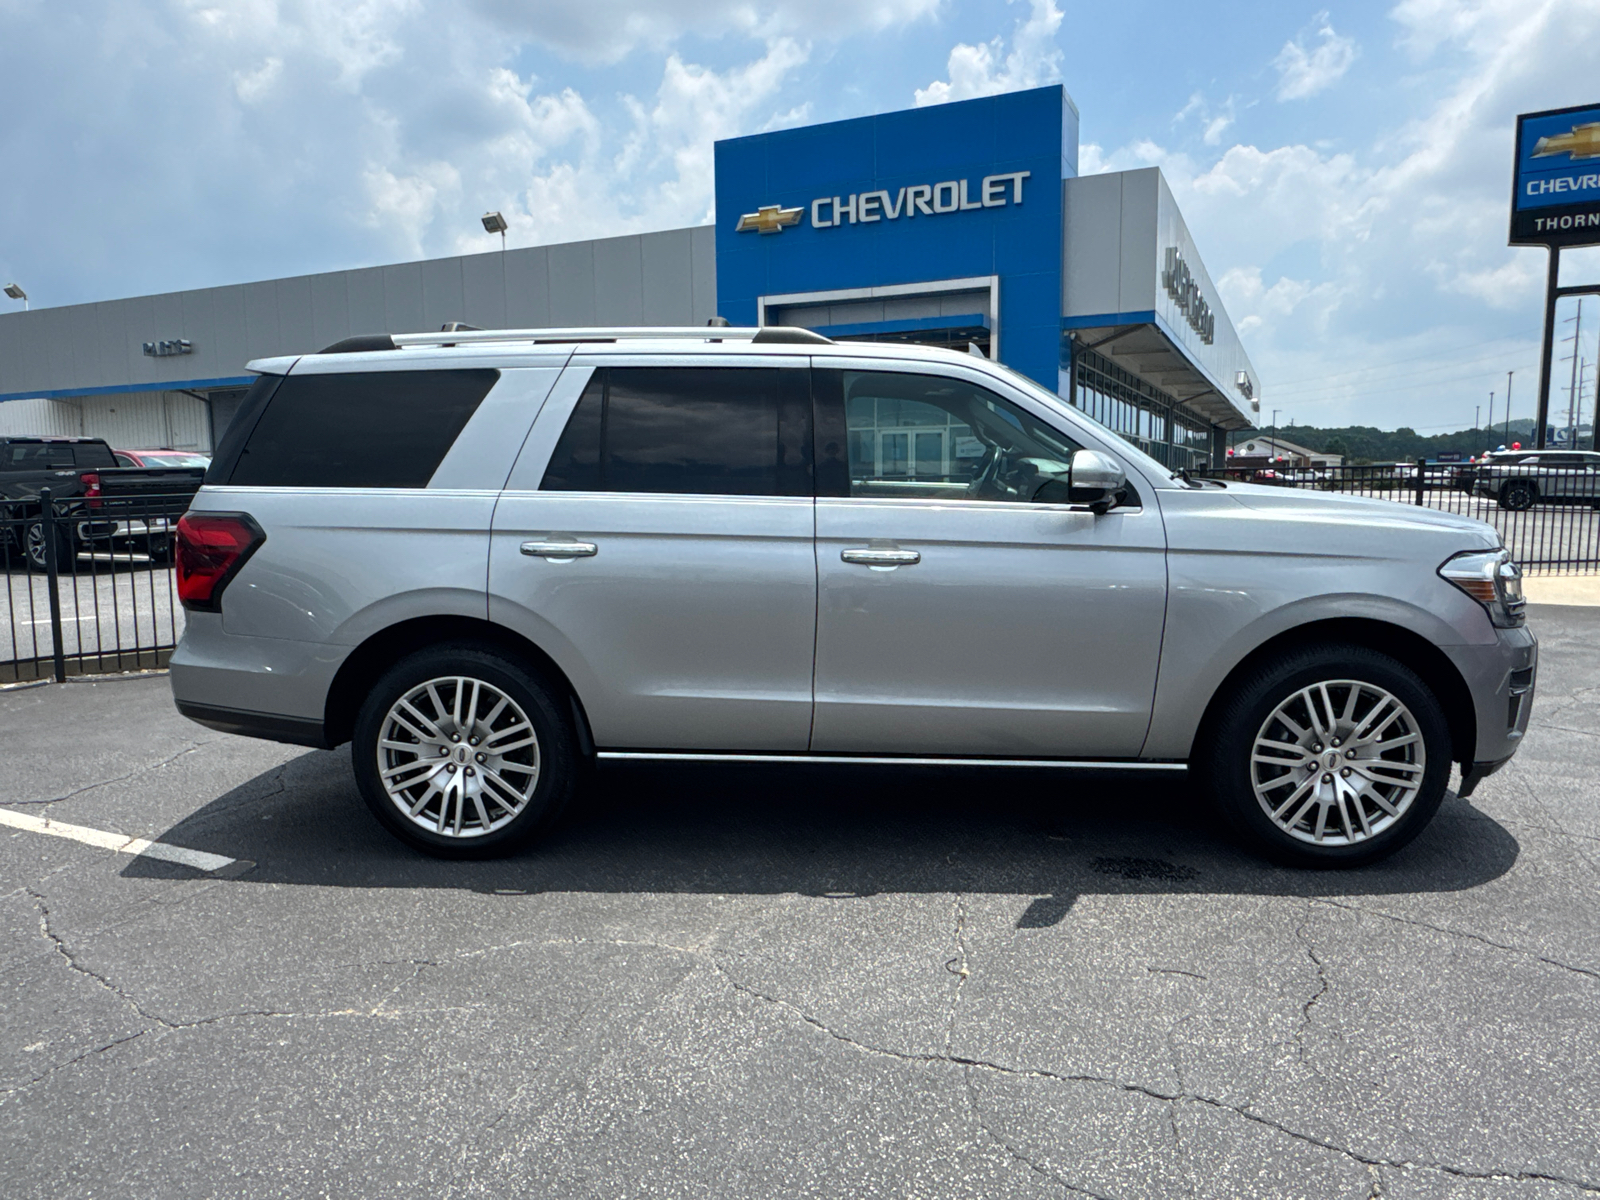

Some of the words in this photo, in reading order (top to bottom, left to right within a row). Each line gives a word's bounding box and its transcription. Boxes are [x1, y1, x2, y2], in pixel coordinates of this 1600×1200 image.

[1527, 174, 1600, 195] CHEVR
[811, 171, 1031, 229] CHEVROLET
[143, 339, 191, 357] PARTS
